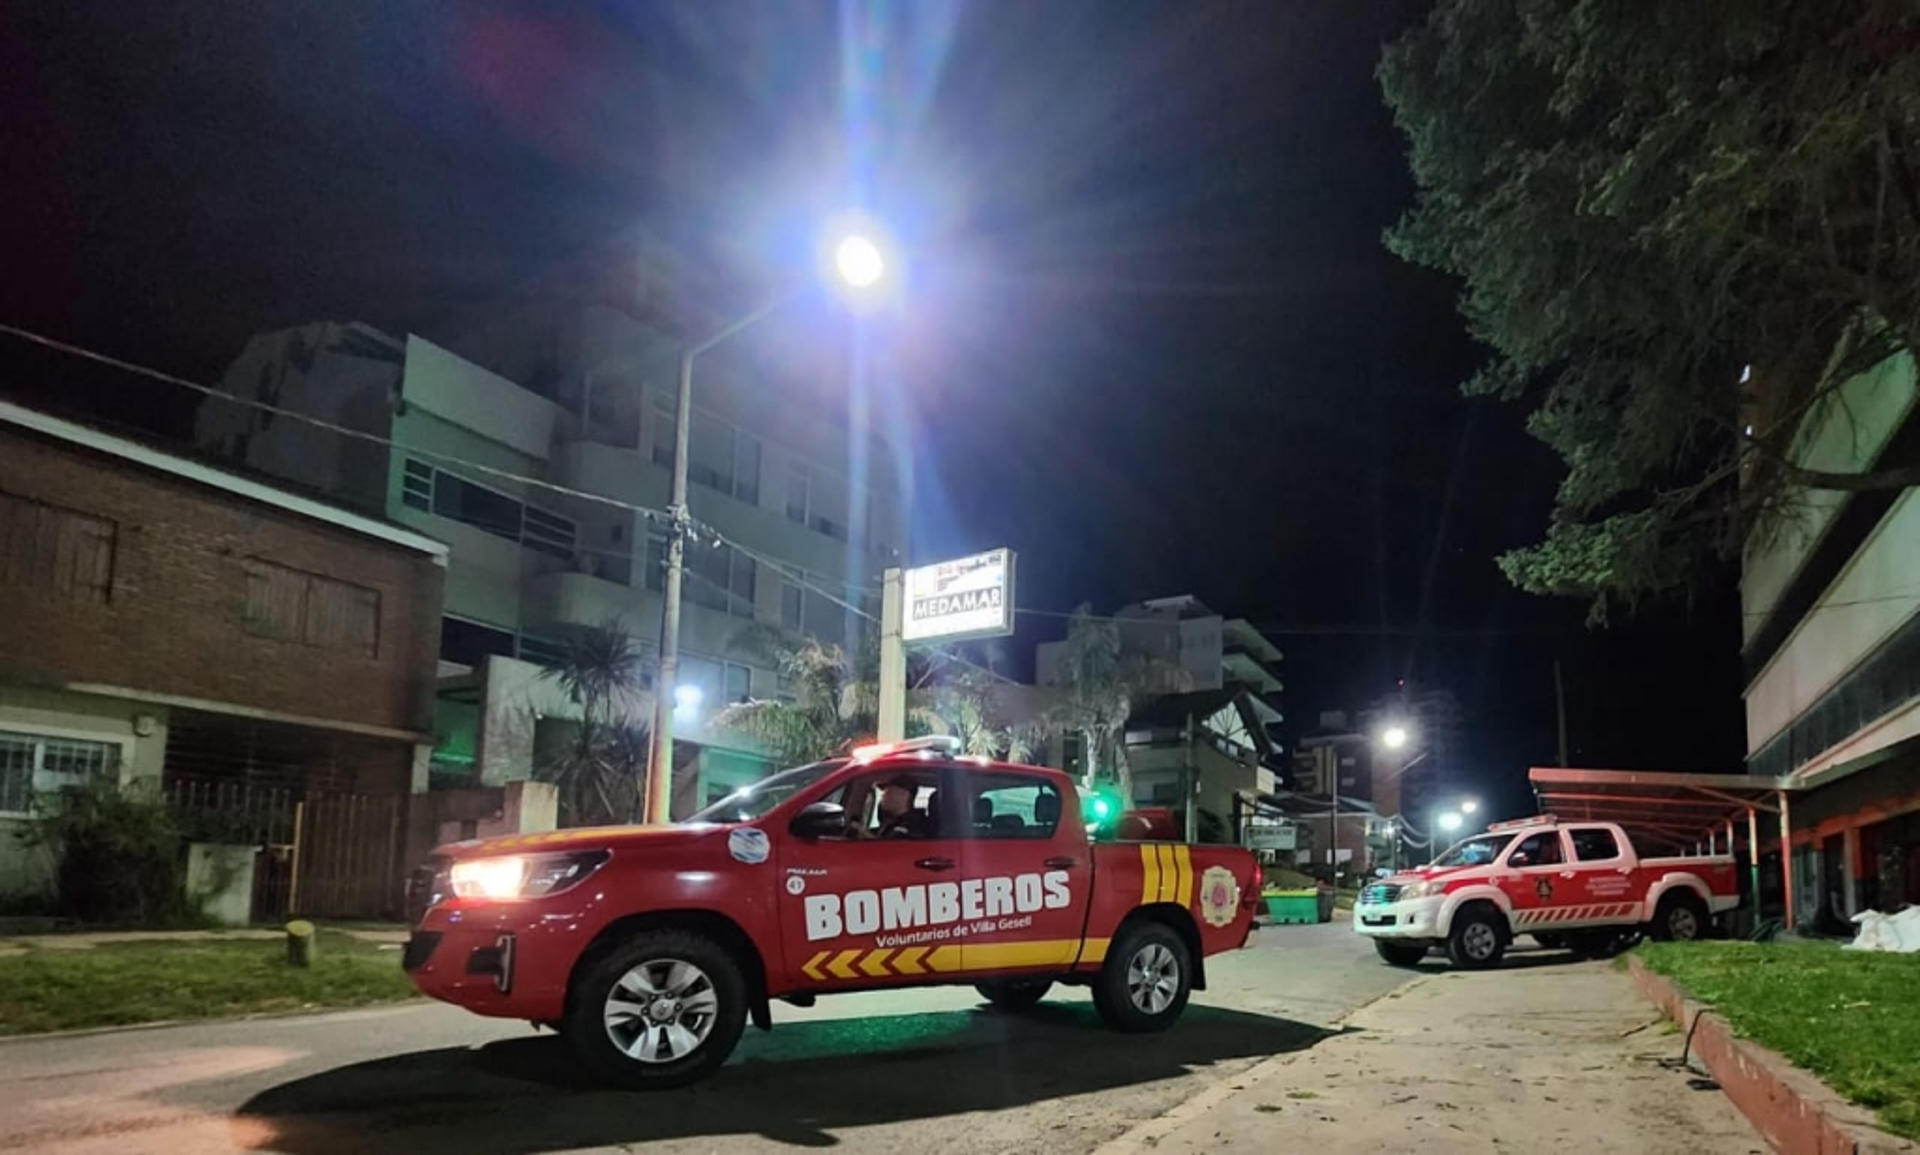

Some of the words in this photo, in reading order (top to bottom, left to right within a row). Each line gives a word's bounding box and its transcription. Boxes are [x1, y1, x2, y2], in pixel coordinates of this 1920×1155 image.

[914, 587, 1001, 619] MEDAMAR
[804, 871, 1071, 941] BOMBEROS
[875, 928, 951, 947] Voluntarios
[953, 924, 968, 936] de
[970, 920, 996, 933] Villa
[998, 915, 1032, 930] Gesell
